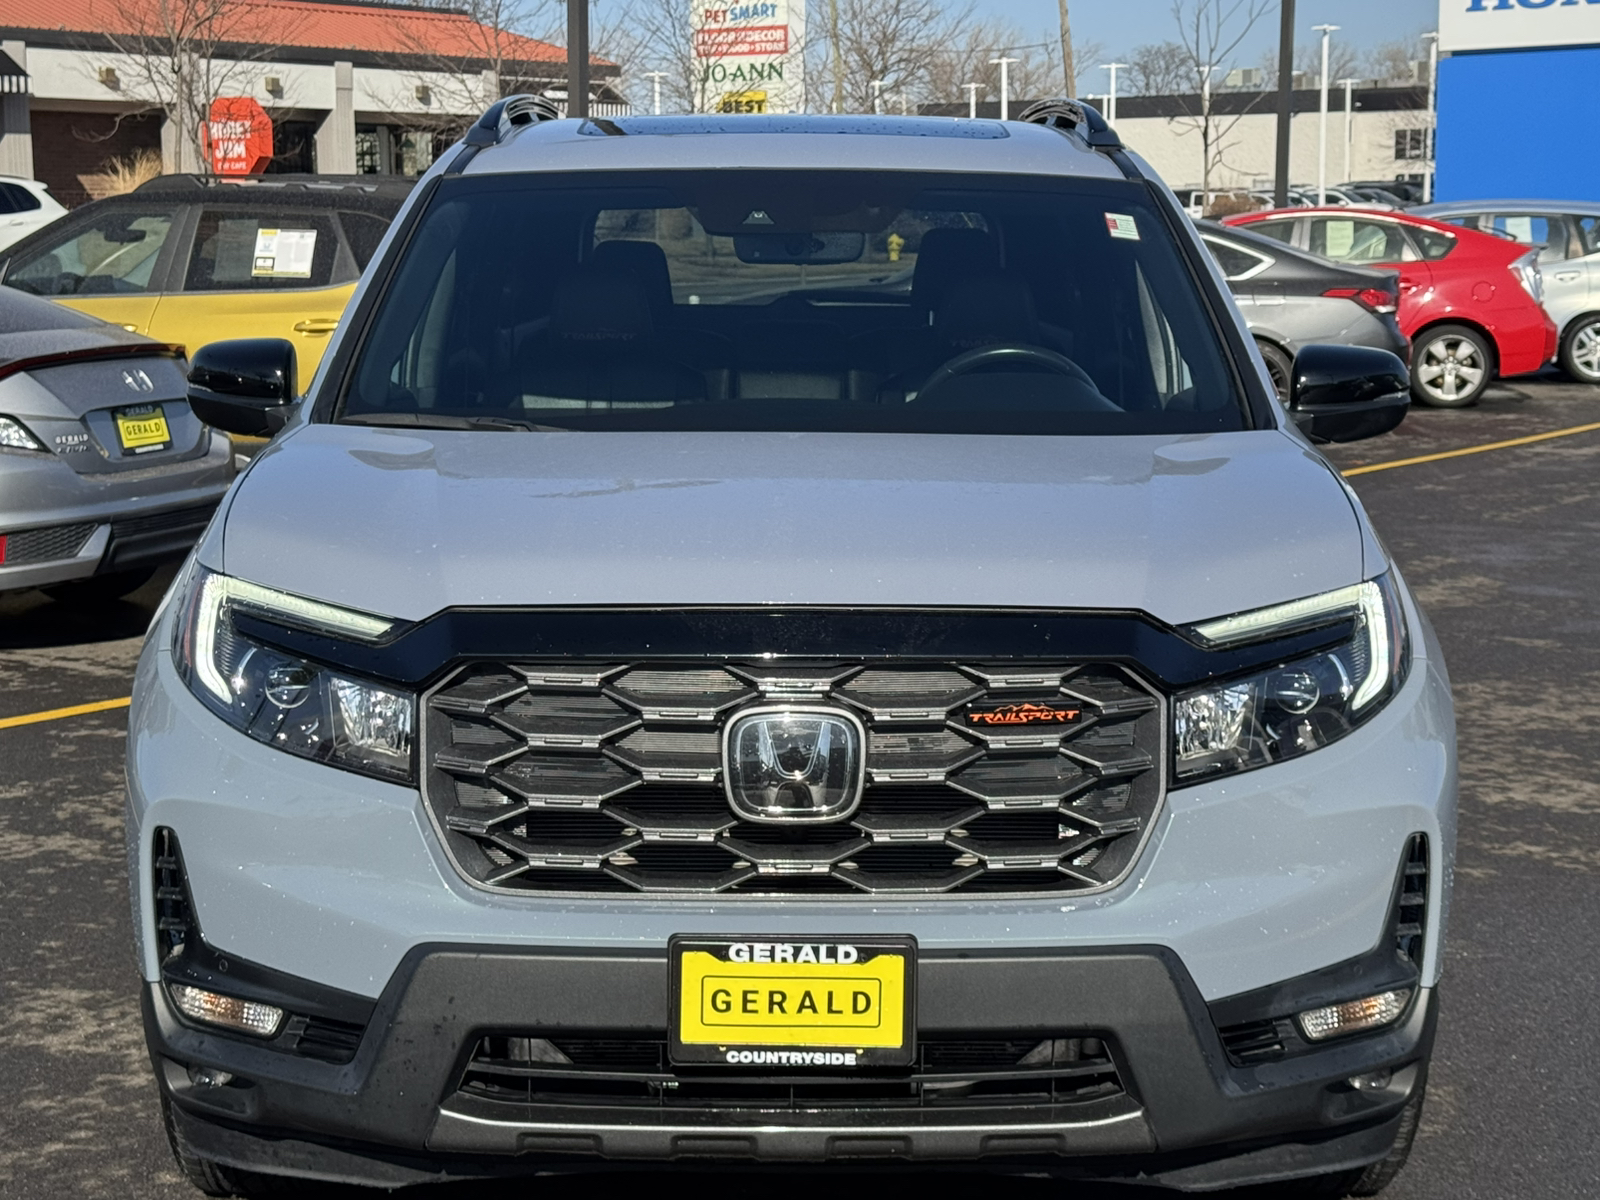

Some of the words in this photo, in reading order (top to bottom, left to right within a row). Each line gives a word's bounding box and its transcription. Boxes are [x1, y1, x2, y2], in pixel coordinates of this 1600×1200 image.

[746, 29, 785, 41] DECOR
[722, 99, 765, 113] BEST
[125, 421, 161, 436] GERALD
[969, 710, 1080, 724] TRAILSPORT
[728, 943, 858, 965] GERALD
[711, 988, 872, 1015] GERALD
[726, 1050, 857, 1066] COUNTRYSIDE
